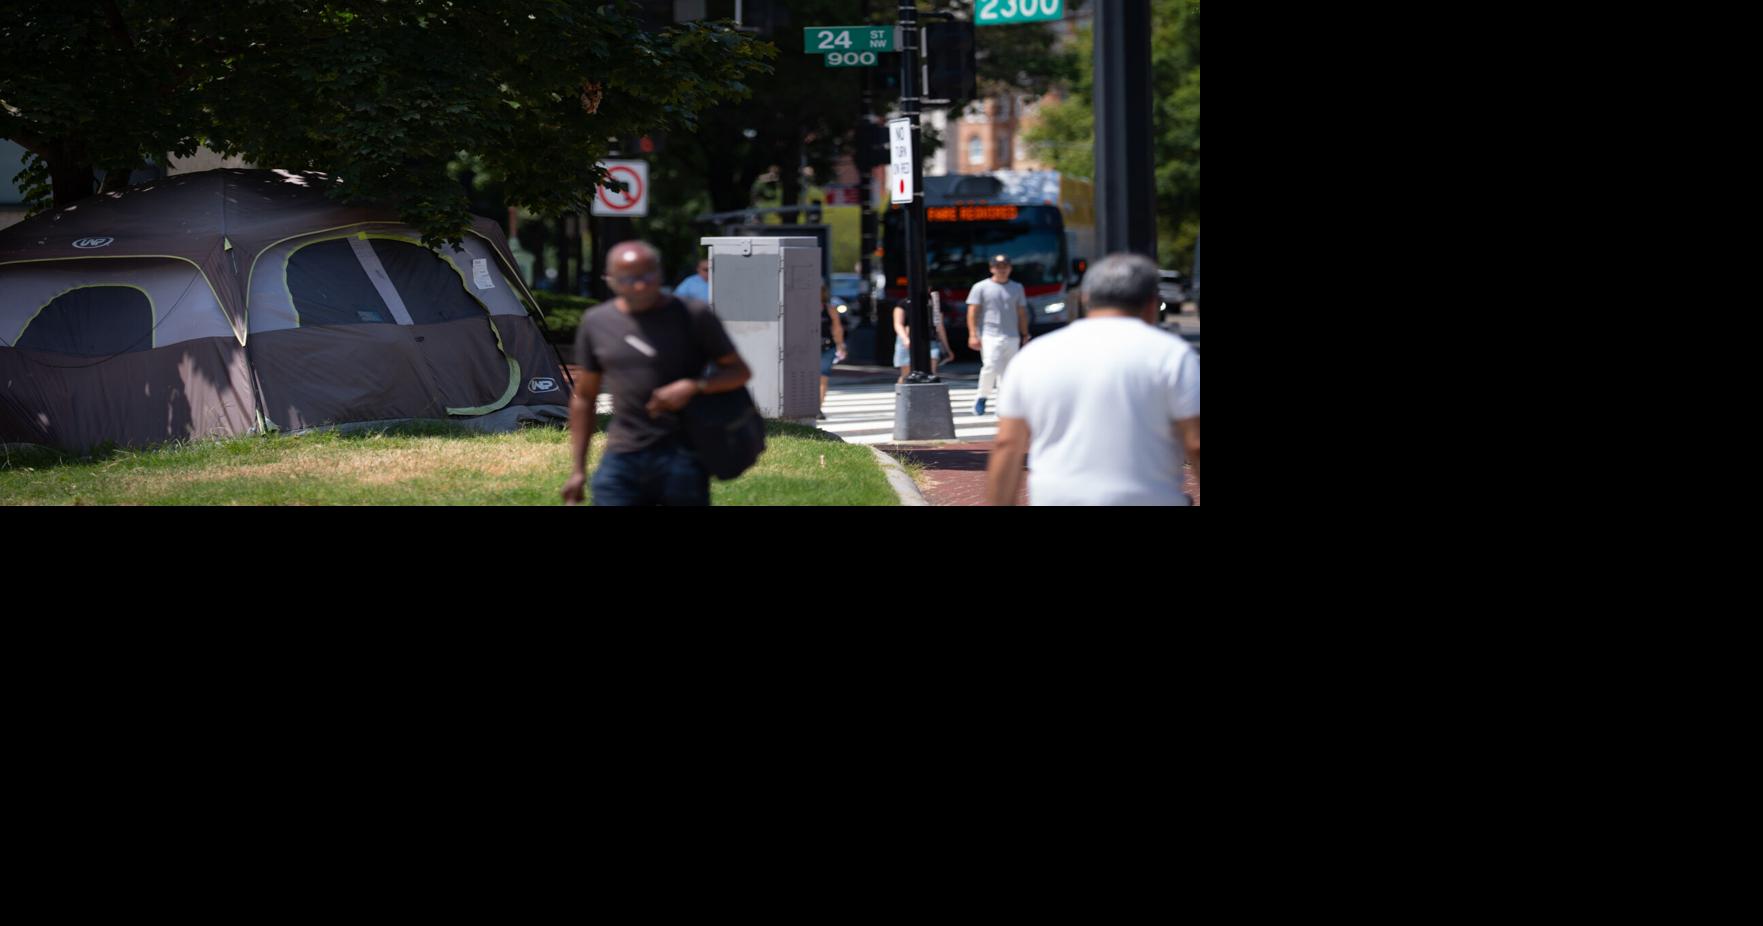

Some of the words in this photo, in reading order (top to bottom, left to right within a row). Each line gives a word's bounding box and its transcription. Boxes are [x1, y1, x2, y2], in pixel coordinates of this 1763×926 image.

[979, 0, 1060, 20] 2300
[816, 30, 853, 50] 24
[870, 30, 885, 39] ST
[870, 39, 887, 48] NW
[827, 51, 876, 65] 900
